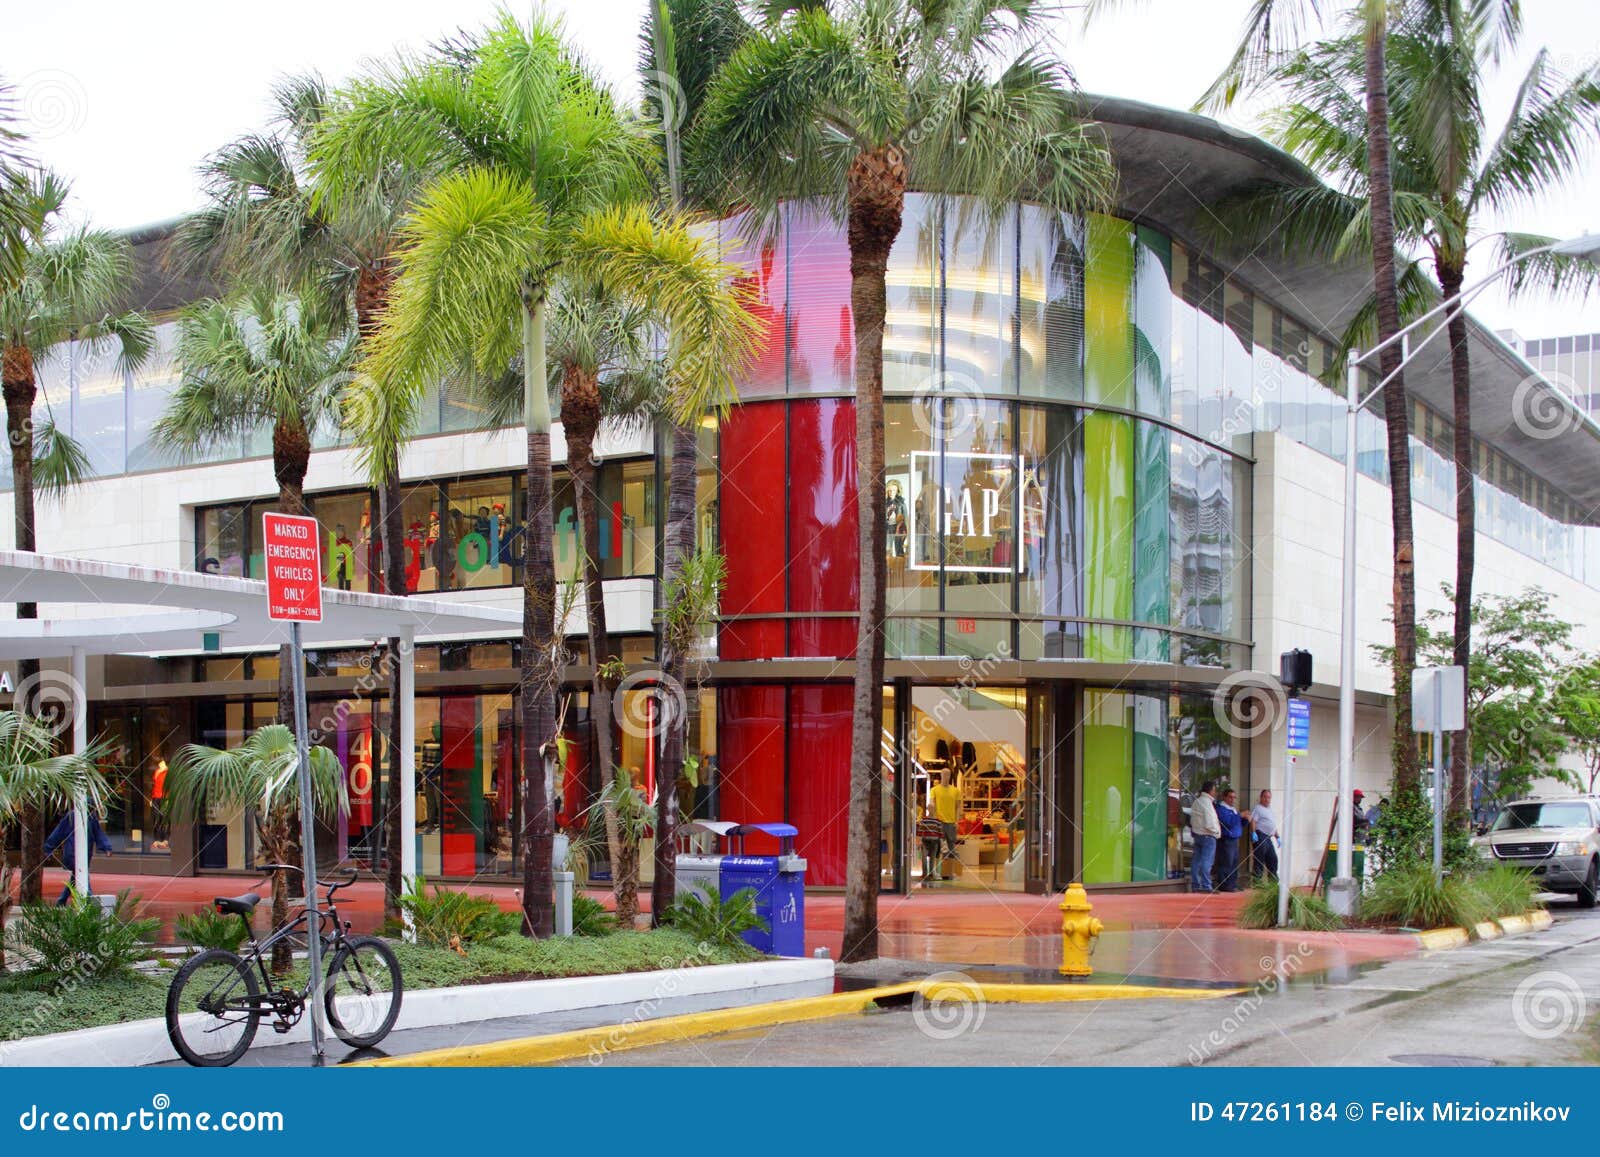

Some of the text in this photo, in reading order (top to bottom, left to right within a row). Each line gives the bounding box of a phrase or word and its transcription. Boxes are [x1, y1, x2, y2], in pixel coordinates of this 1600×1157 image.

[936, 488, 999, 537] GAP
[274, 523, 308, 539] MARKED
[268, 544, 316, 560] EMERGENCY
[274, 565, 313, 581] VEHICLES
[284, 587, 305, 601] ONLY
